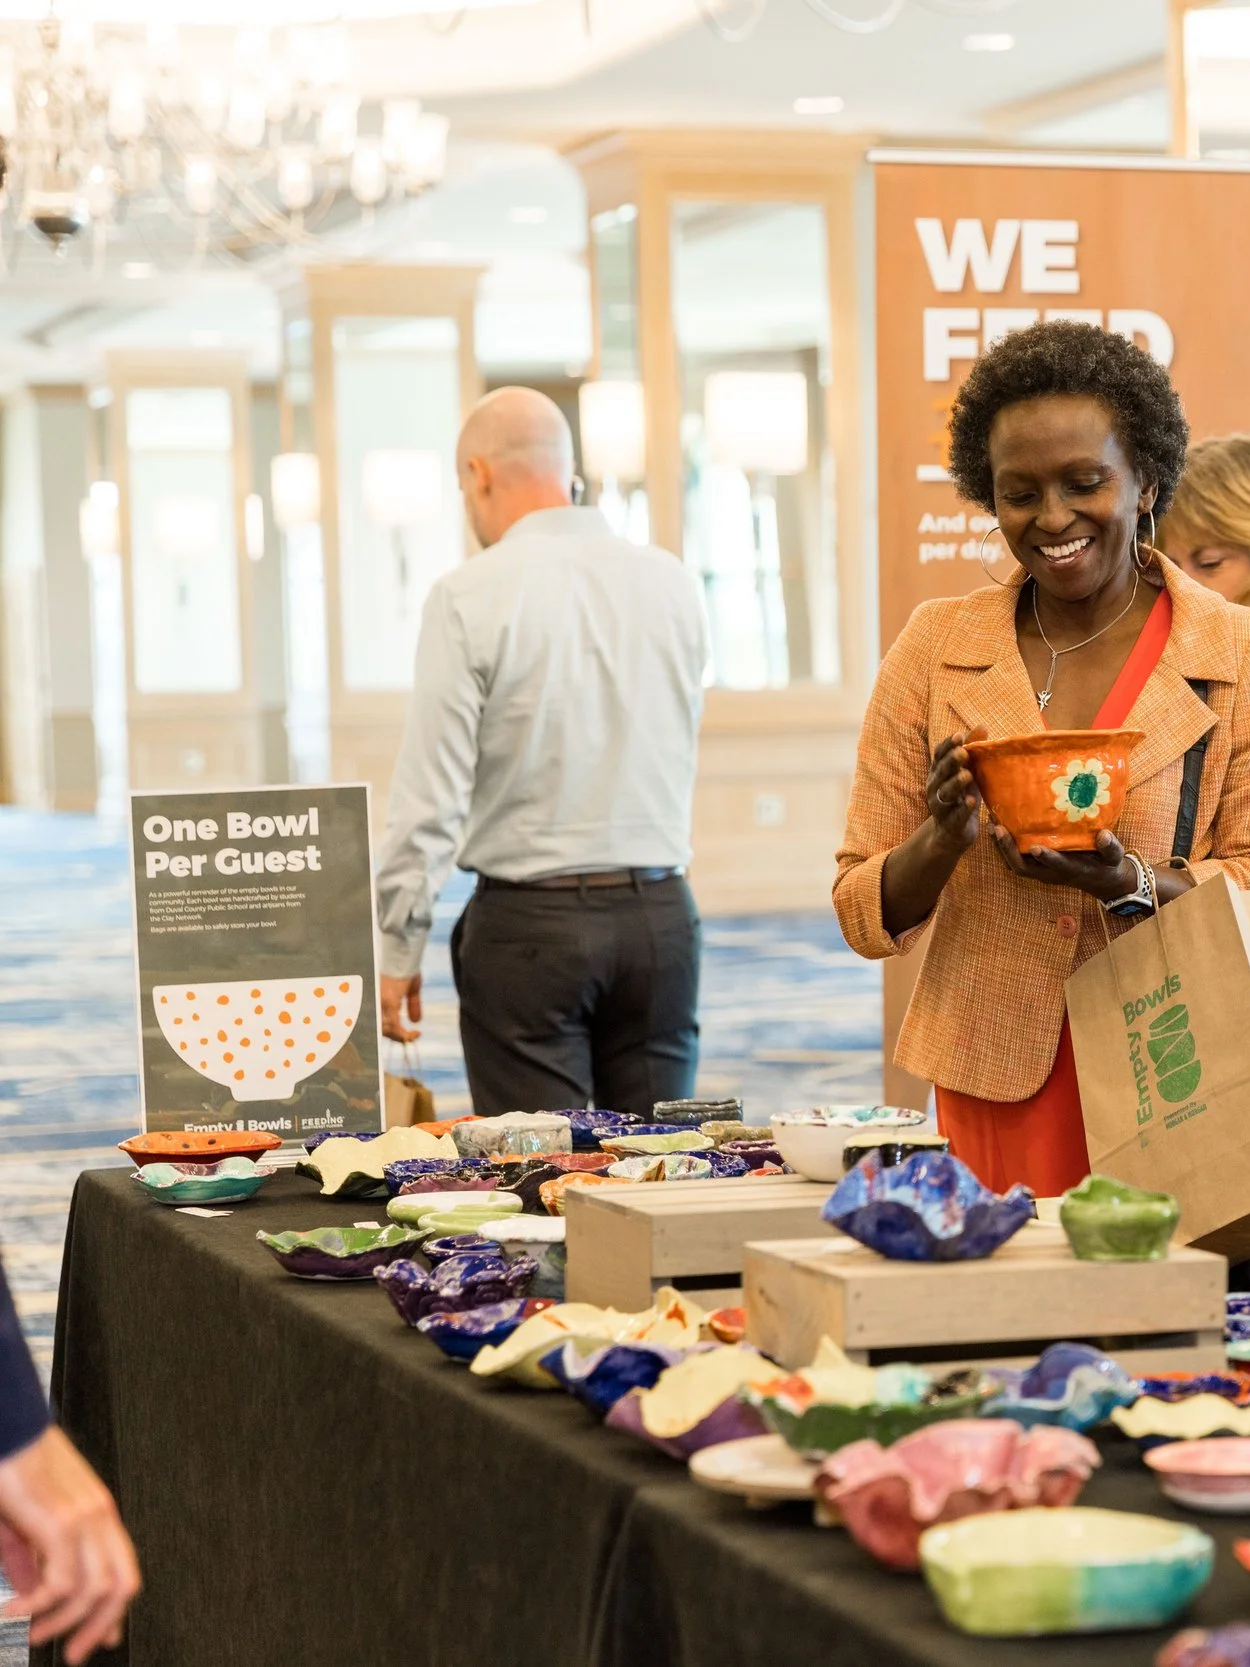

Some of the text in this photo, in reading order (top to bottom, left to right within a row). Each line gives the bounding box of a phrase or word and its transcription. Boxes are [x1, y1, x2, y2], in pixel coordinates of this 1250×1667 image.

[915, 217, 1080, 294] WE
[923, 307, 1175, 382] FD
[918, 512, 1000, 534] And ov
[919, 542, 958, 565] per
[143, 807, 319, 843] One Bowl
[145, 845, 322, 879] Per Guest
[163, 889, 190, 899] powerful
[191, 888, 219, 896] reminder
[260, 885, 278, 893] bowls
[202, 896, 218, 904] bowl
[232, 894, 270, 902] handcrafted
[270, 893, 278, 901] by
[279, 892, 306, 900] students
[161, 914, 174, 922] Clay
[165, 906, 183, 914] Duval
[184, 905, 206, 913] County
[207, 904, 227, 912] Public
[285, 900, 302, 908] from
[150, 926, 166, 934] Bags
[212, 922, 230, 931] safely
[246, 922, 260, 930] your
[1122, 973, 1182, 1028] Bowls
[1127, 1031, 1154, 1126] Empty
[248, 1117, 292, 1131] Bowls
[301, 1113, 344, 1126] FEEDING
